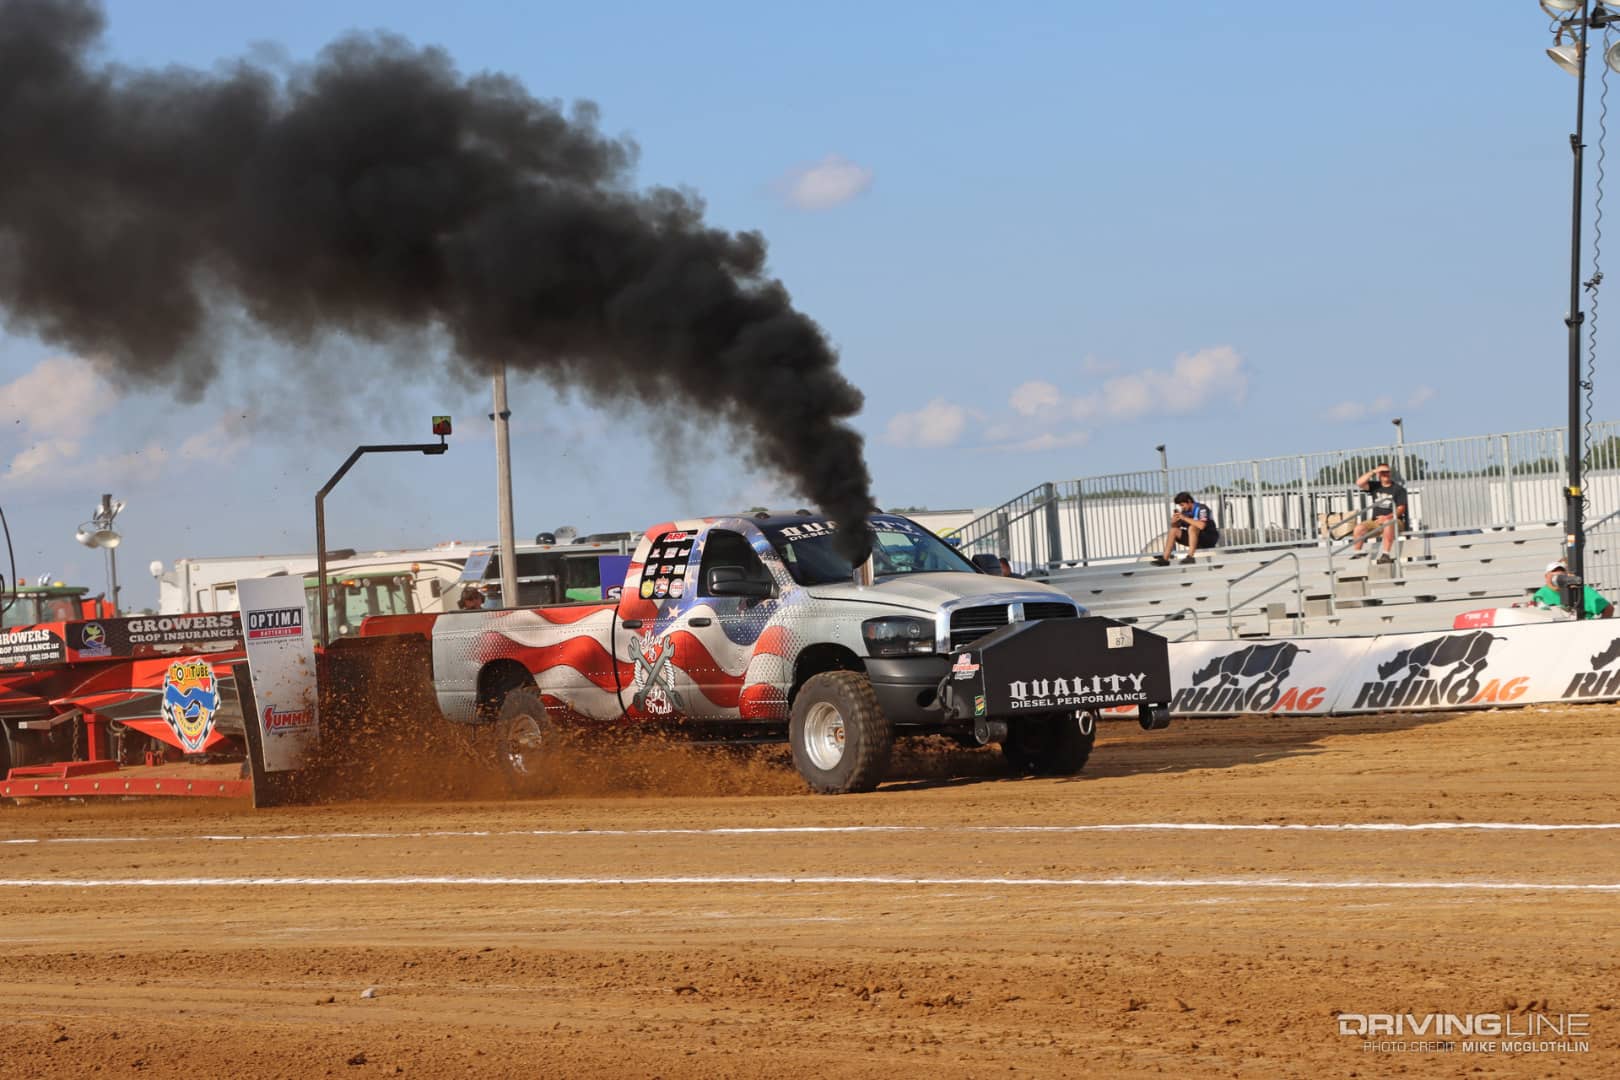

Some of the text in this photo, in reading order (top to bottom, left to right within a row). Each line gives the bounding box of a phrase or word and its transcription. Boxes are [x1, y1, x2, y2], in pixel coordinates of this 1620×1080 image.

[128, 615, 233, 632] GROWERS
[250, 611, 300, 628] OPTIMA
[129, 633, 161, 643] CROP
[164, 629, 234, 641] INSURANCE
[13, 643, 50, 653] INSURANCE
[1008, 672, 1147, 700] QUALITY
[1011, 692, 1147, 709] DIESEL PERFORMANCE
